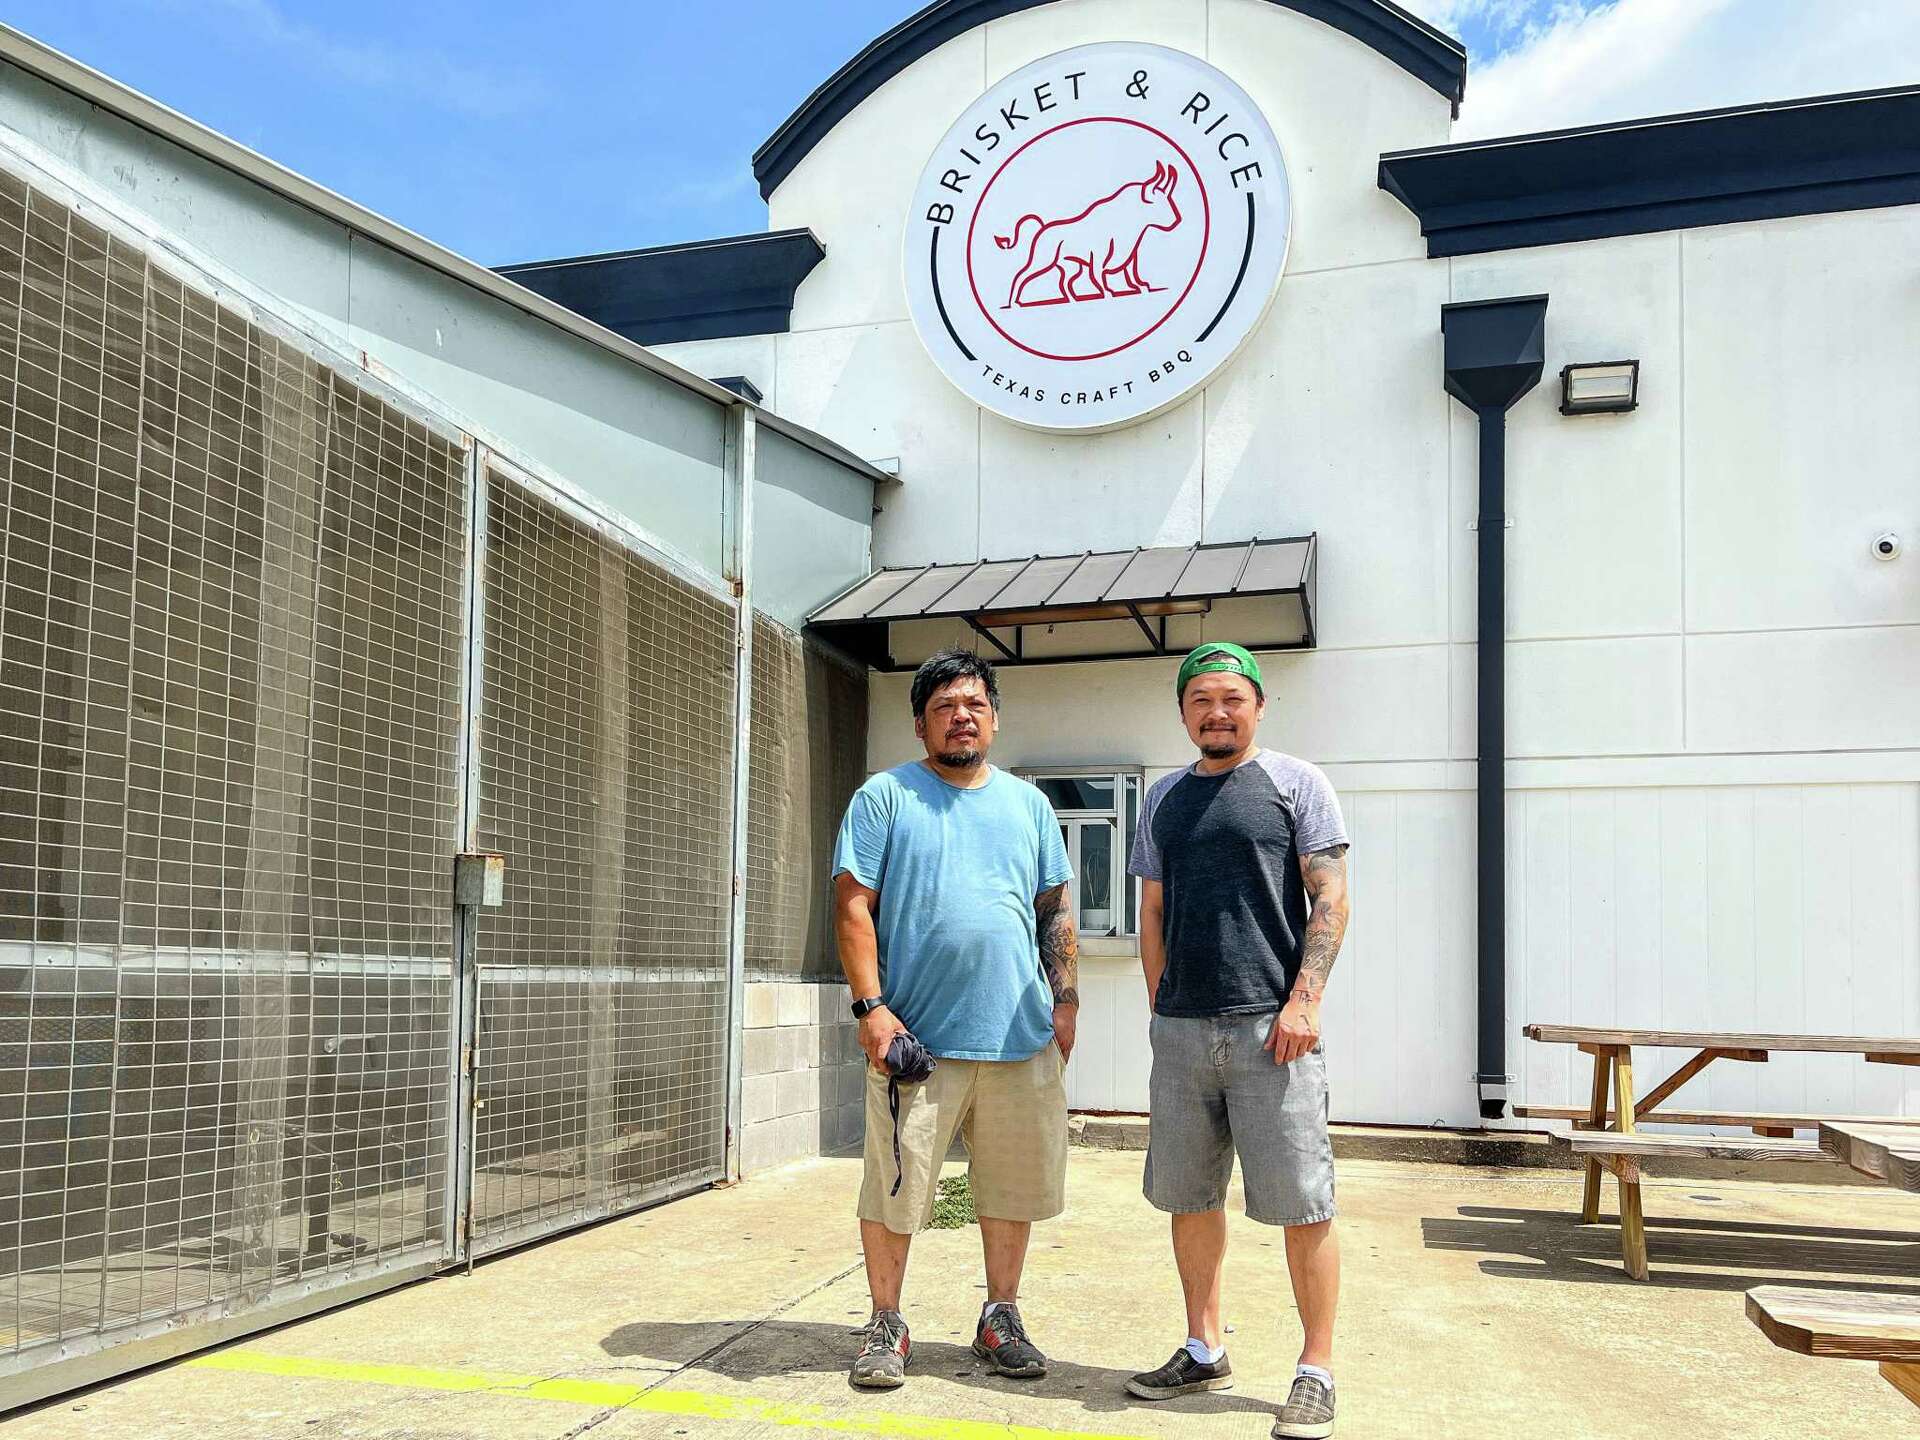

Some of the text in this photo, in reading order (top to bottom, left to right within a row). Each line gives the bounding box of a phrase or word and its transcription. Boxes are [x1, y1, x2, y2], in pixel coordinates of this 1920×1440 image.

[926, 70, 1263, 225] BRISKET & RICE
[982, 350, 1193, 405] TEXAS CRAFT BBQ
